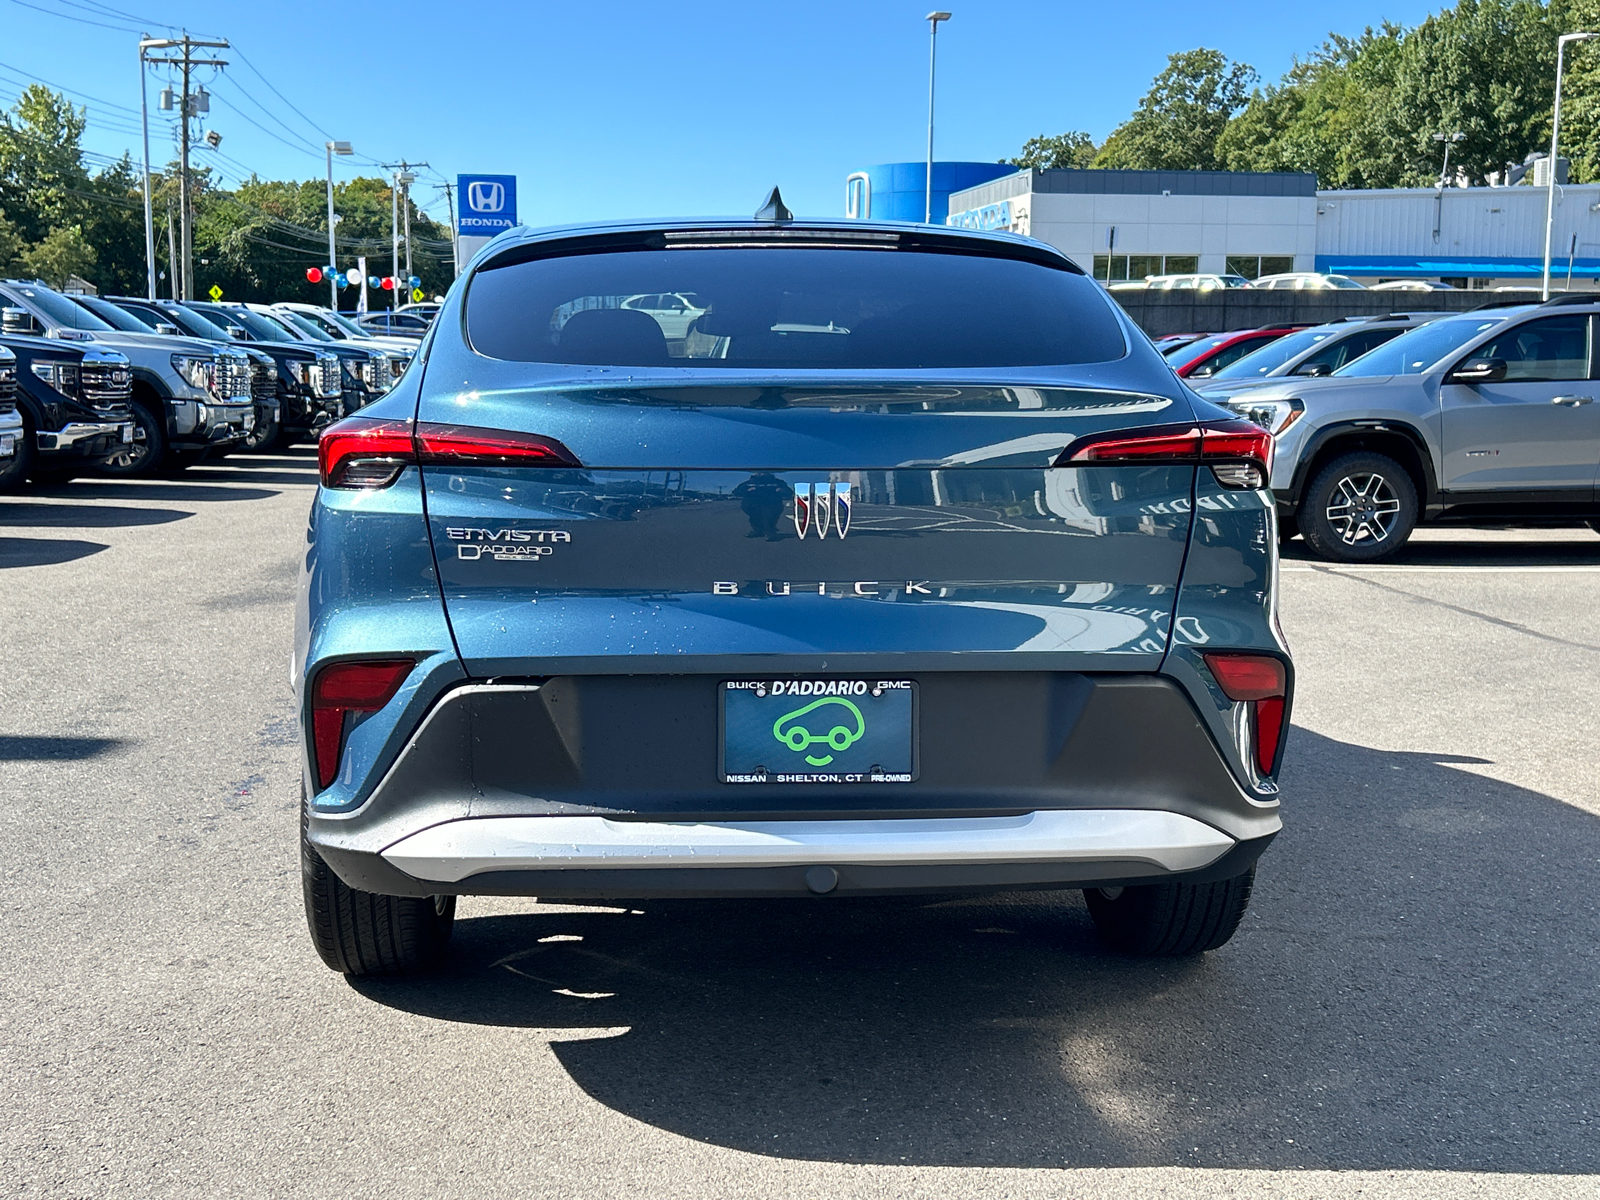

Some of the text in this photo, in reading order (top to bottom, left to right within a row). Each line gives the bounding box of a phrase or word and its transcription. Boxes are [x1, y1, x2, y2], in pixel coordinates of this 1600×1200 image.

[460, 218, 514, 228] HONDA
[446, 527, 571, 542] ENVISTA
[458, 544, 553, 560] D'ADDARIO
[713, 581, 931, 595] BUICK
[771, 681, 868, 696] D'ADDARIO
[877, 681, 911, 689] GMC
[777, 774, 842, 783] SHELTON,
[845, 774, 864, 782] CT
